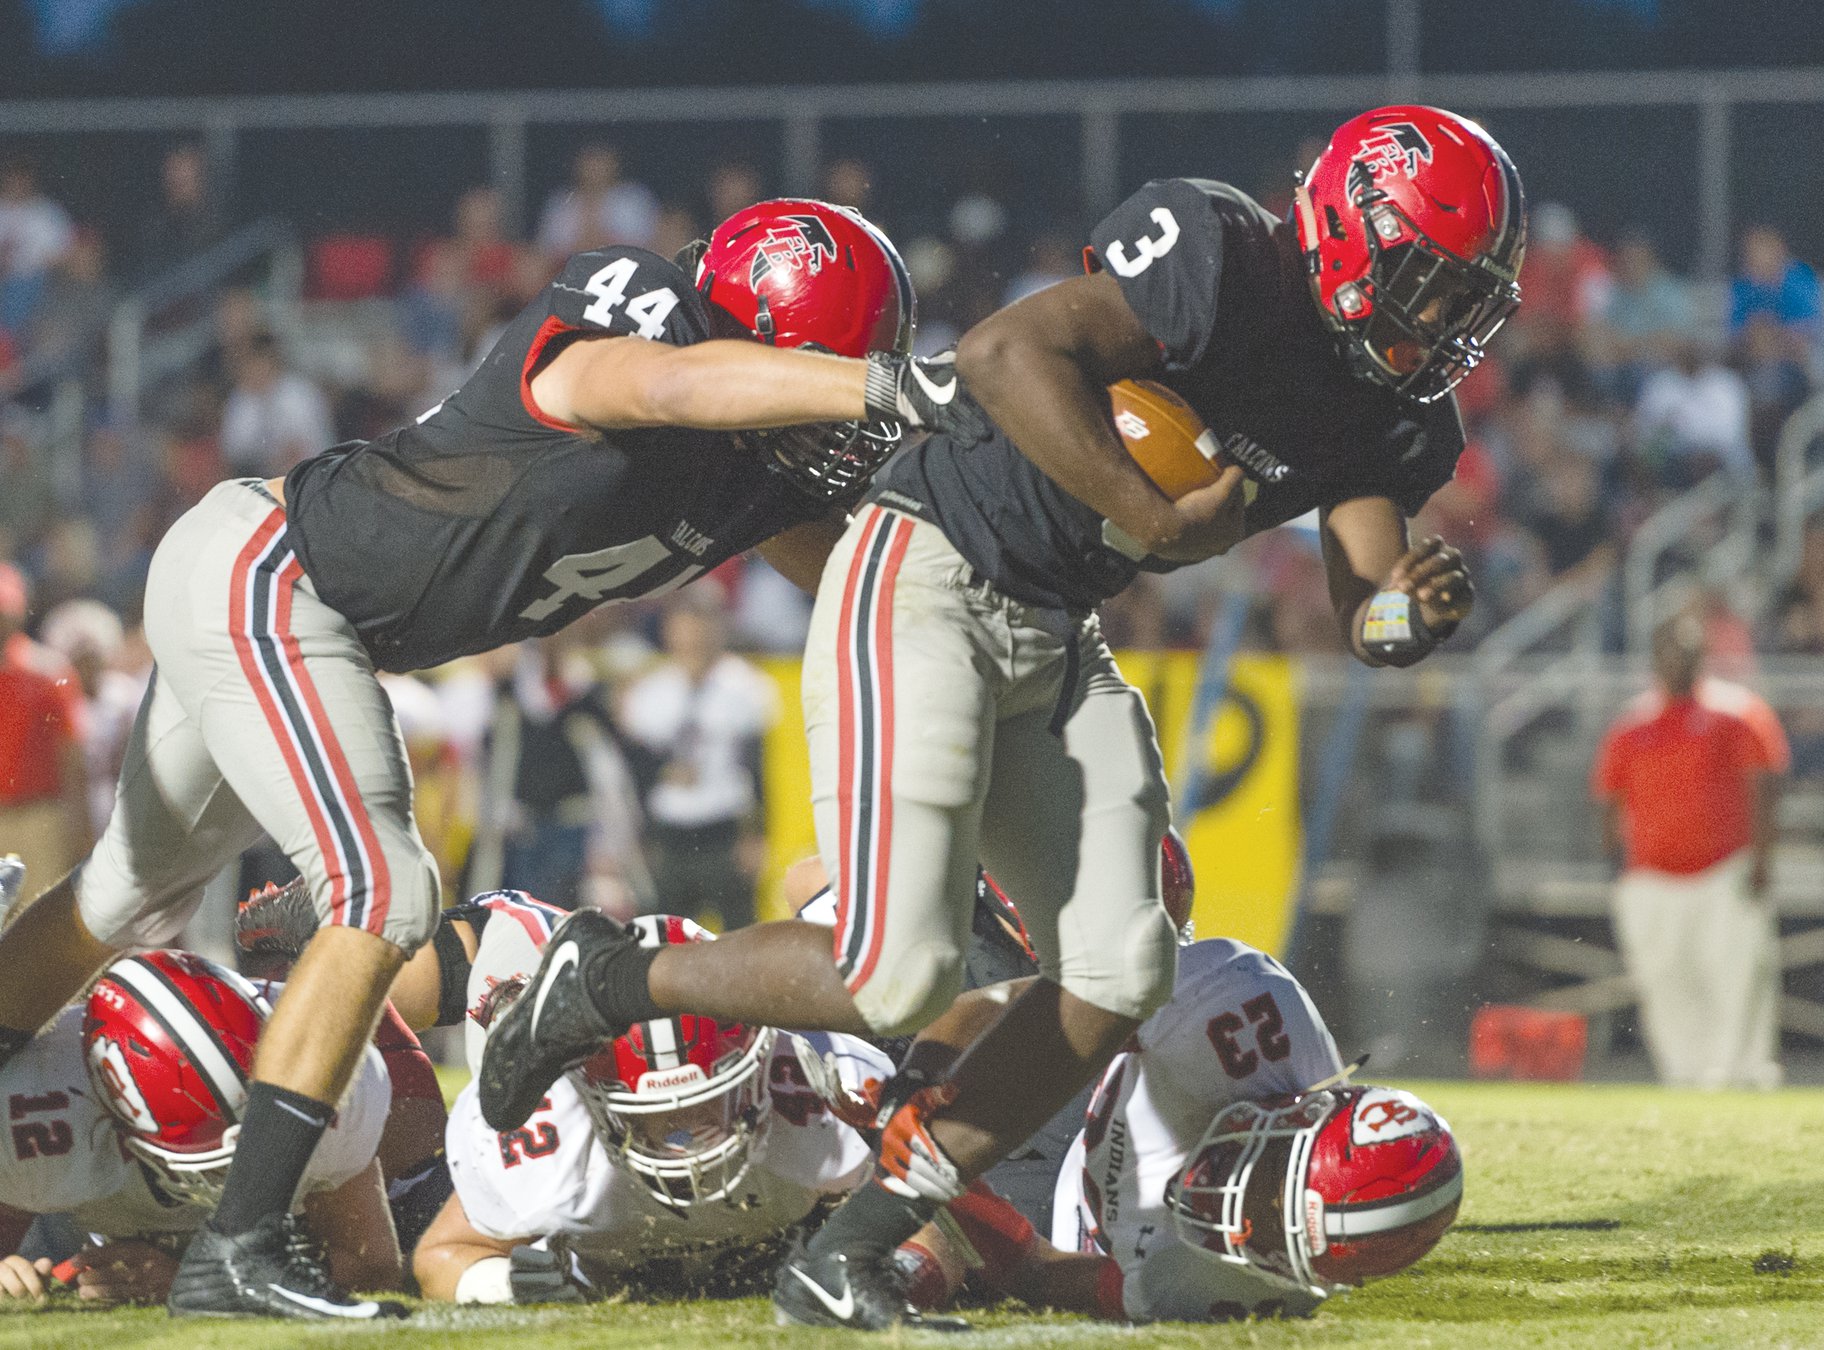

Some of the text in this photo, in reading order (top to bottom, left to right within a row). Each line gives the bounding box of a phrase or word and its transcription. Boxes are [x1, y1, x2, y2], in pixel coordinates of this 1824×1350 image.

[1105, 206, 1181, 278] 3
[582, 257, 681, 342] 44
[1206, 991, 1291, 1080] 23
[646, 1071, 699, 1089] Riddell
[8, 1091, 75, 1161] 12
[1105, 1118, 1126, 1222] INDIANS
